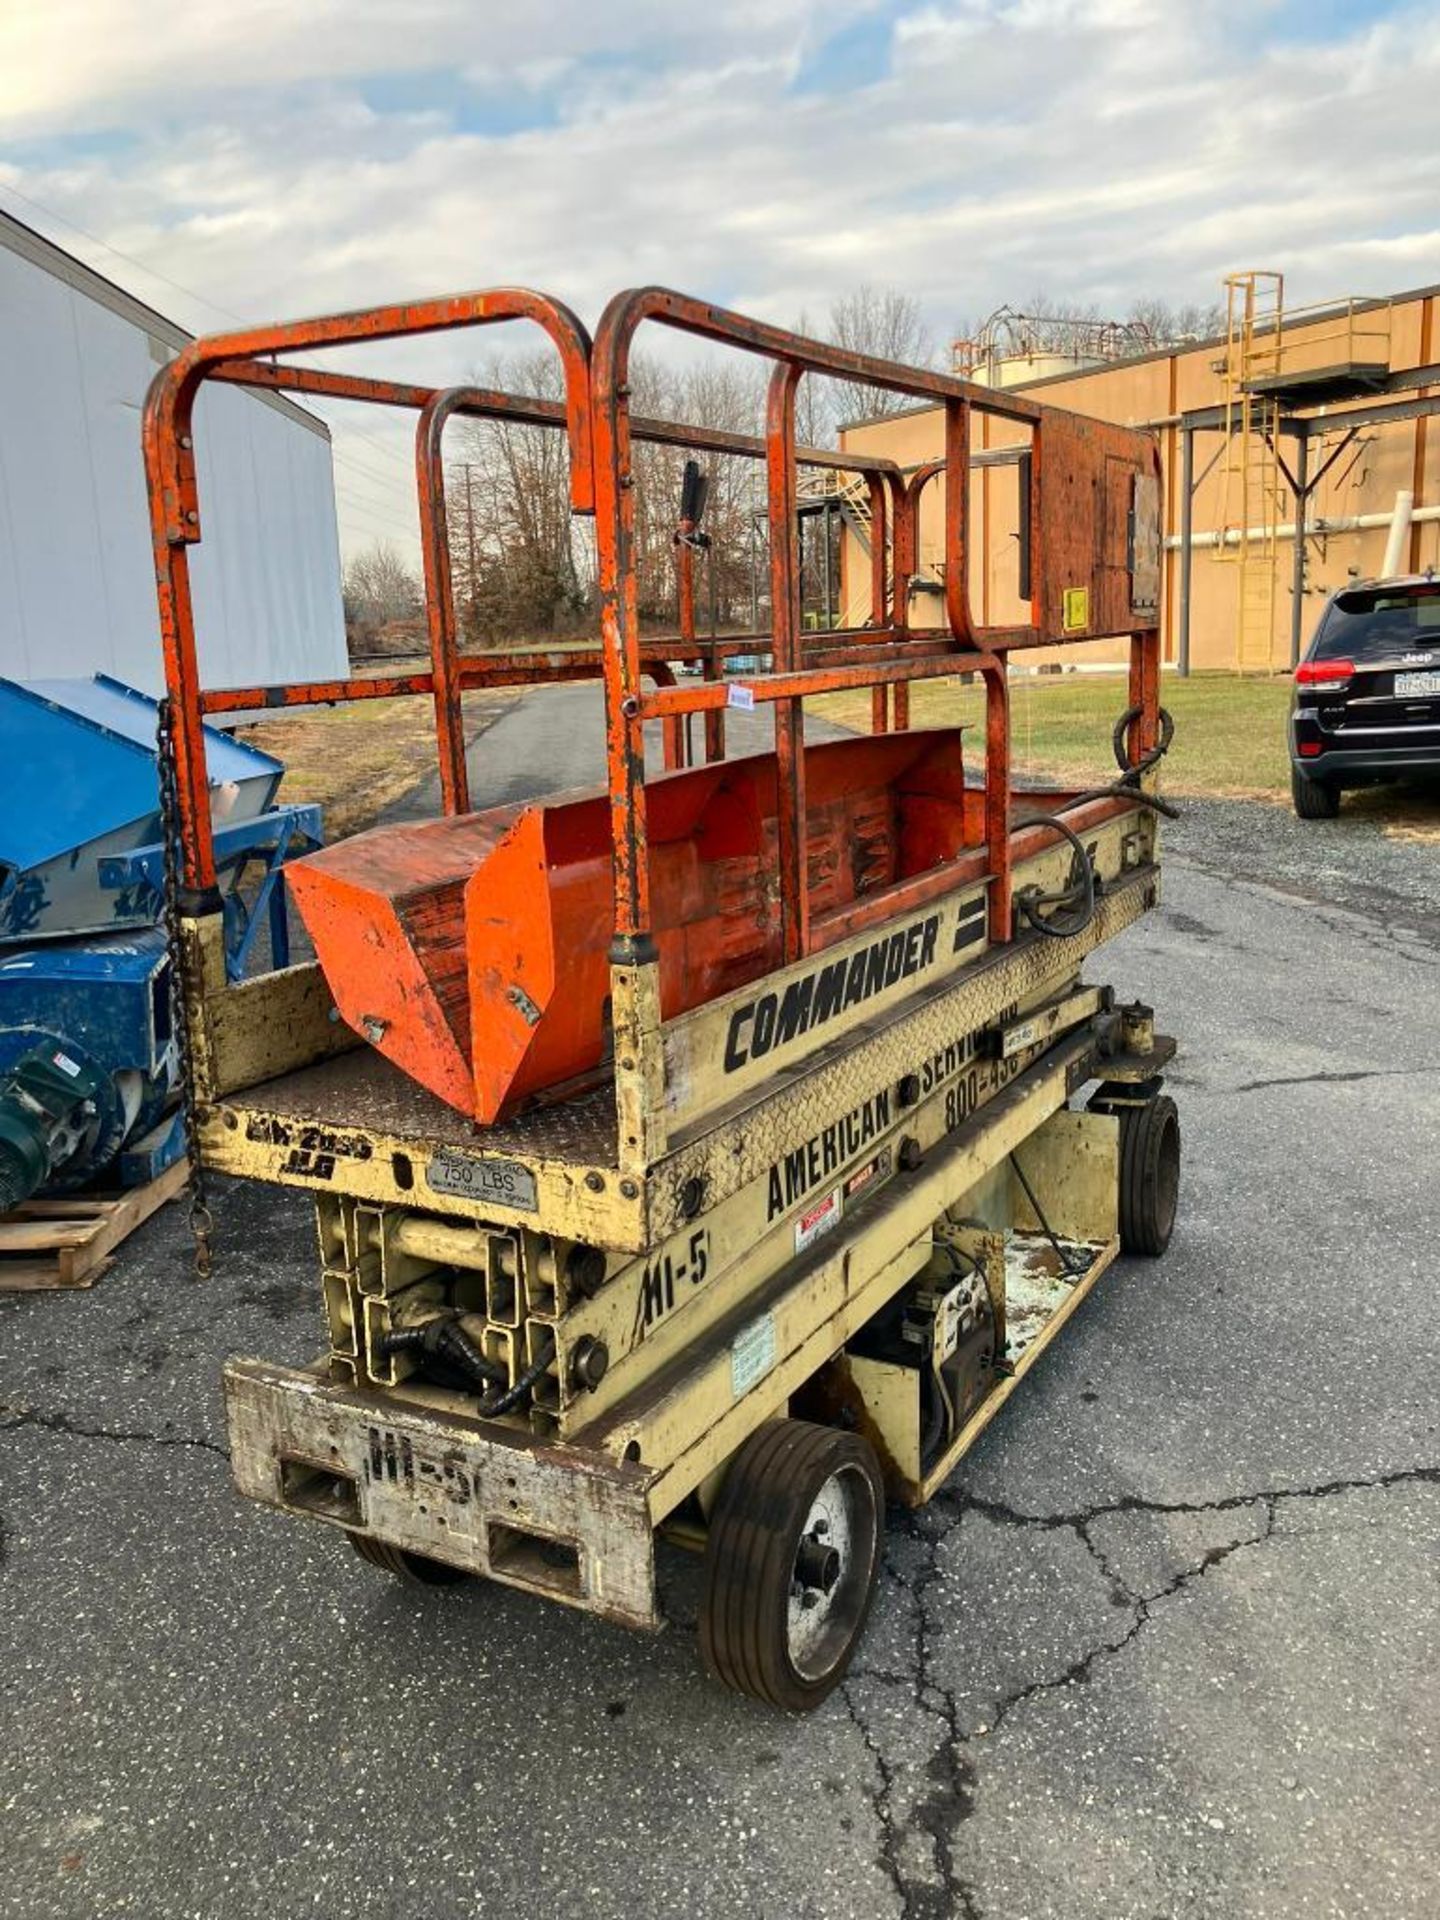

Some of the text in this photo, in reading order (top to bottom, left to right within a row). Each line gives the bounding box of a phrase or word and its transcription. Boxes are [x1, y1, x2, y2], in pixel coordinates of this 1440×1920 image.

[1402, 653, 1432, 663] Jeep
[724, 915, 939, 1073] COMMANDER
[441, 1161, 473, 1184] 750
[482, 1171, 516, 1193] LBS
[768, 1088, 889, 1223] AMERICAN
[640, 1228, 707, 1328] MI-5
